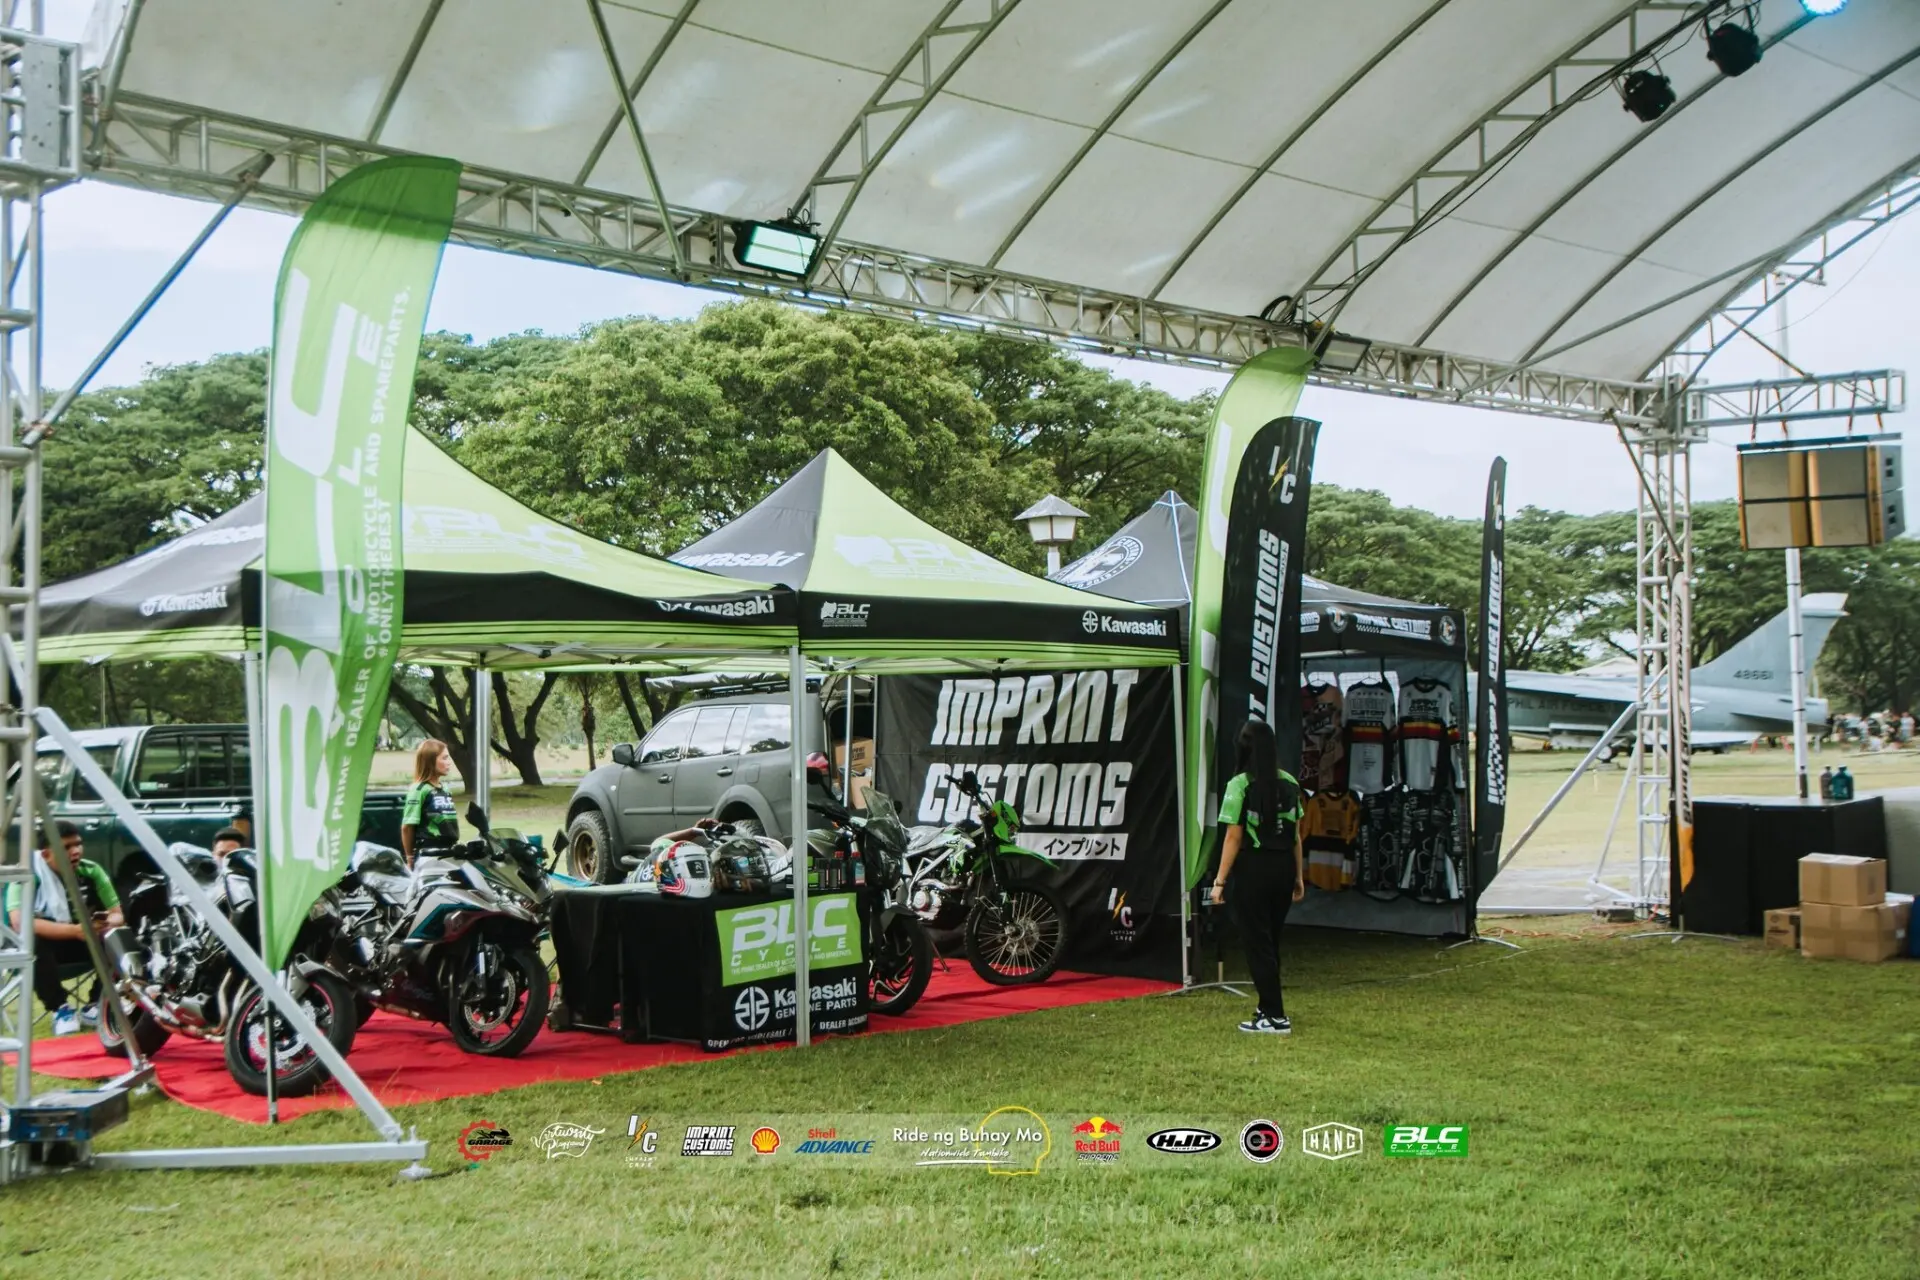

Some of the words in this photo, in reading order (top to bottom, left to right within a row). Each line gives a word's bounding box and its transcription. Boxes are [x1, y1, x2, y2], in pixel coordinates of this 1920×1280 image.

[364, 433, 382, 476] AND
[363, 484, 380, 628] MOTORCYCLE
[376, 498, 395, 659] #ONLYTHEBEST
[156, 586, 228, 612] Kawasaki
[836, 603, 871, 615] BLC
[1251, 529, 1281, 687] CUSTOMS
[1101, 615, 1167, 636] Kawasaki
[1391, 618, 1432, 634] CUSTOMS
[363, 636, 376, 659] OF
[345, 673, 370, 748] DEALER
[931, 669, 1139, 746] IMPRINT
[332, 755, 353, 821] PRIME
[917, 762, 1133, 826] CUSTOMS
[328, 828, 342, 870] THE
[1044, 837, 1121, 857] インプリント
[731, 898, 849, 952] BLC
[731, 938, 847, 967] CYCLE
[775, 1001, 821, 1019] GENNE
[826, 997, 857, 1010] PARTS
[819, 1019, 846, 1030] DEALER
[708, 1039, 729, 1049] OPEN
